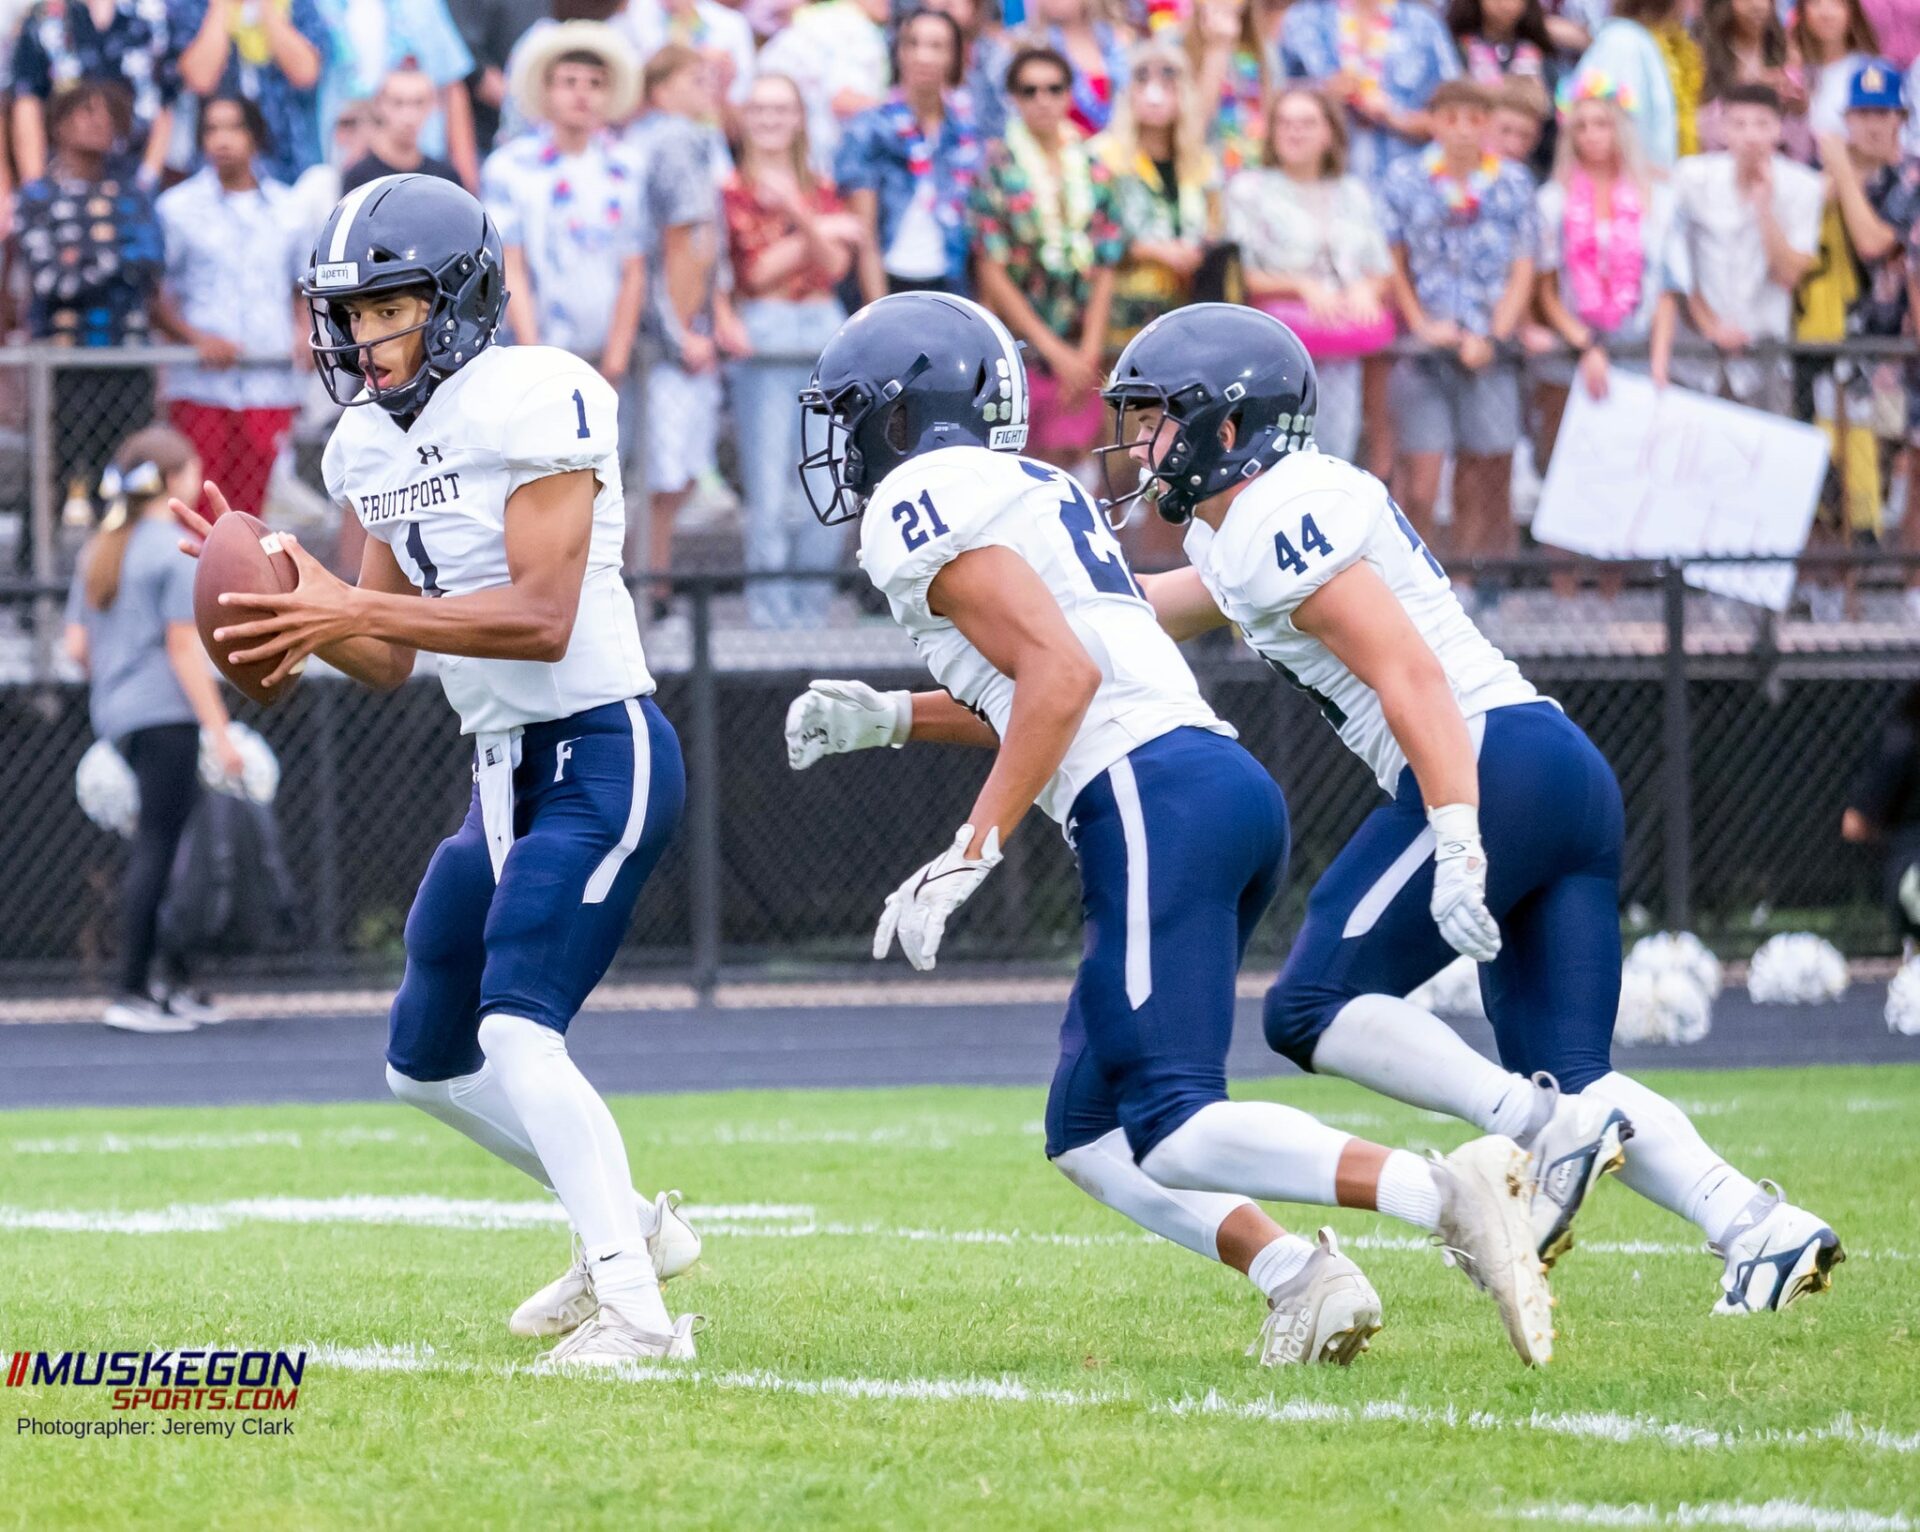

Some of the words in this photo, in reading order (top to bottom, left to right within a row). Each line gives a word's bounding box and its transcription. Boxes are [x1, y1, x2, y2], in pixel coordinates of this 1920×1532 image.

[571, 388, 591, 439] 1
[359, 472, 461, 523] FRUITPORT
[891, 488, 951, 553] 21
[1273, 512, 1335, 576] 44
